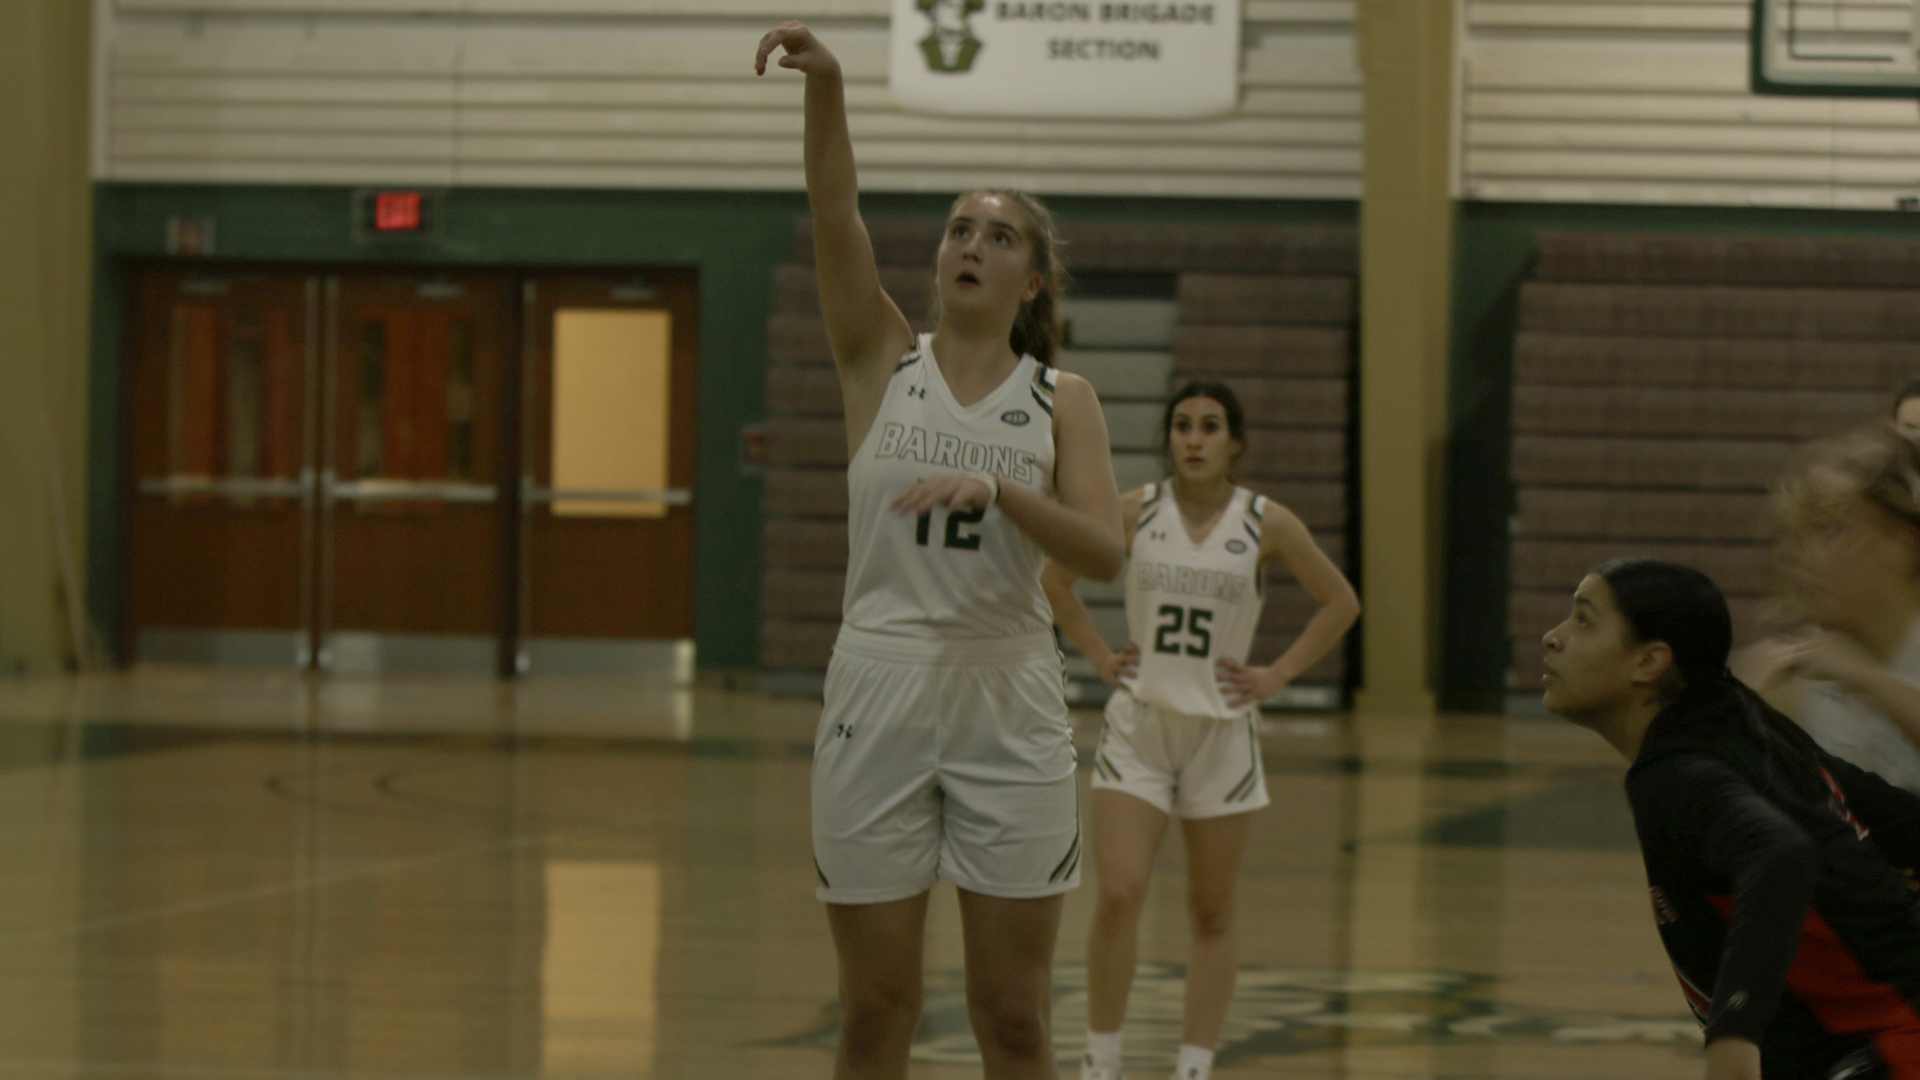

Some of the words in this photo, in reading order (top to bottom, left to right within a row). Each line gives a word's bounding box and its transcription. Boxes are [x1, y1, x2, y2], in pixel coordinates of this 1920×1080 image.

[996, 1, 1089, 21] BARON
[1101, 2, 1214, 24] BRIGADE
[1048, 38, 1160, 60] SECTION
[875, 422, 1036, 484] BARONS
[915, 493, 986, 550] 12
[1137, 562, 1248, 602] BARONS
[1155, 604, 1213, 658] 25
